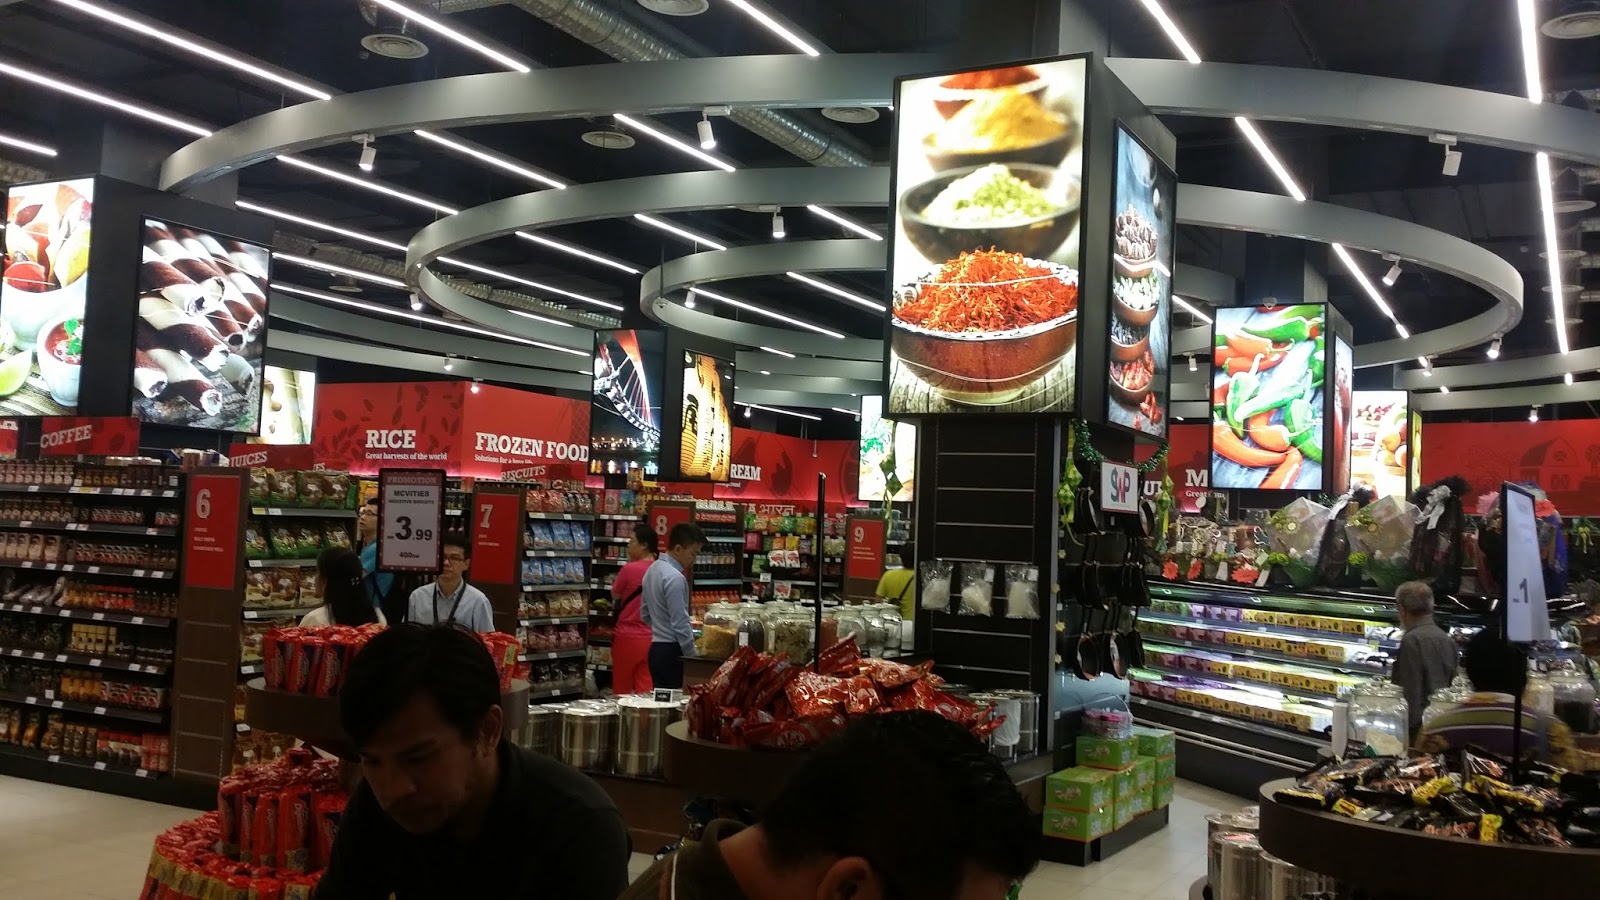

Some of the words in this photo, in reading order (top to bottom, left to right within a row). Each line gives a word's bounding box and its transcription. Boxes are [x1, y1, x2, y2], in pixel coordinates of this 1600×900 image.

[40, 425, 92, 448] COFFEE
[365, 429, 416, 449] RICE
[475, 431, 544, 457] FROZEN
[365, 452, 382, 460] Great
[383, 451, 409, 460] harvests
[410, 452, 417, 460] of
[418, 452, 428, 460] the
[429, 452, 447, 460] world
[475, 453, 499, 463] Solutions
[387, 476, 436, 484] PROMOTION
[730, 463, 761, 481] REAM
[196, 488, 211, 519] 6
[480, 504, 493, 528] 7
[655, 514, 668, 536] 8
[395, 516, 432, 541] 3.99
[854, 526, 864, 543] 9
